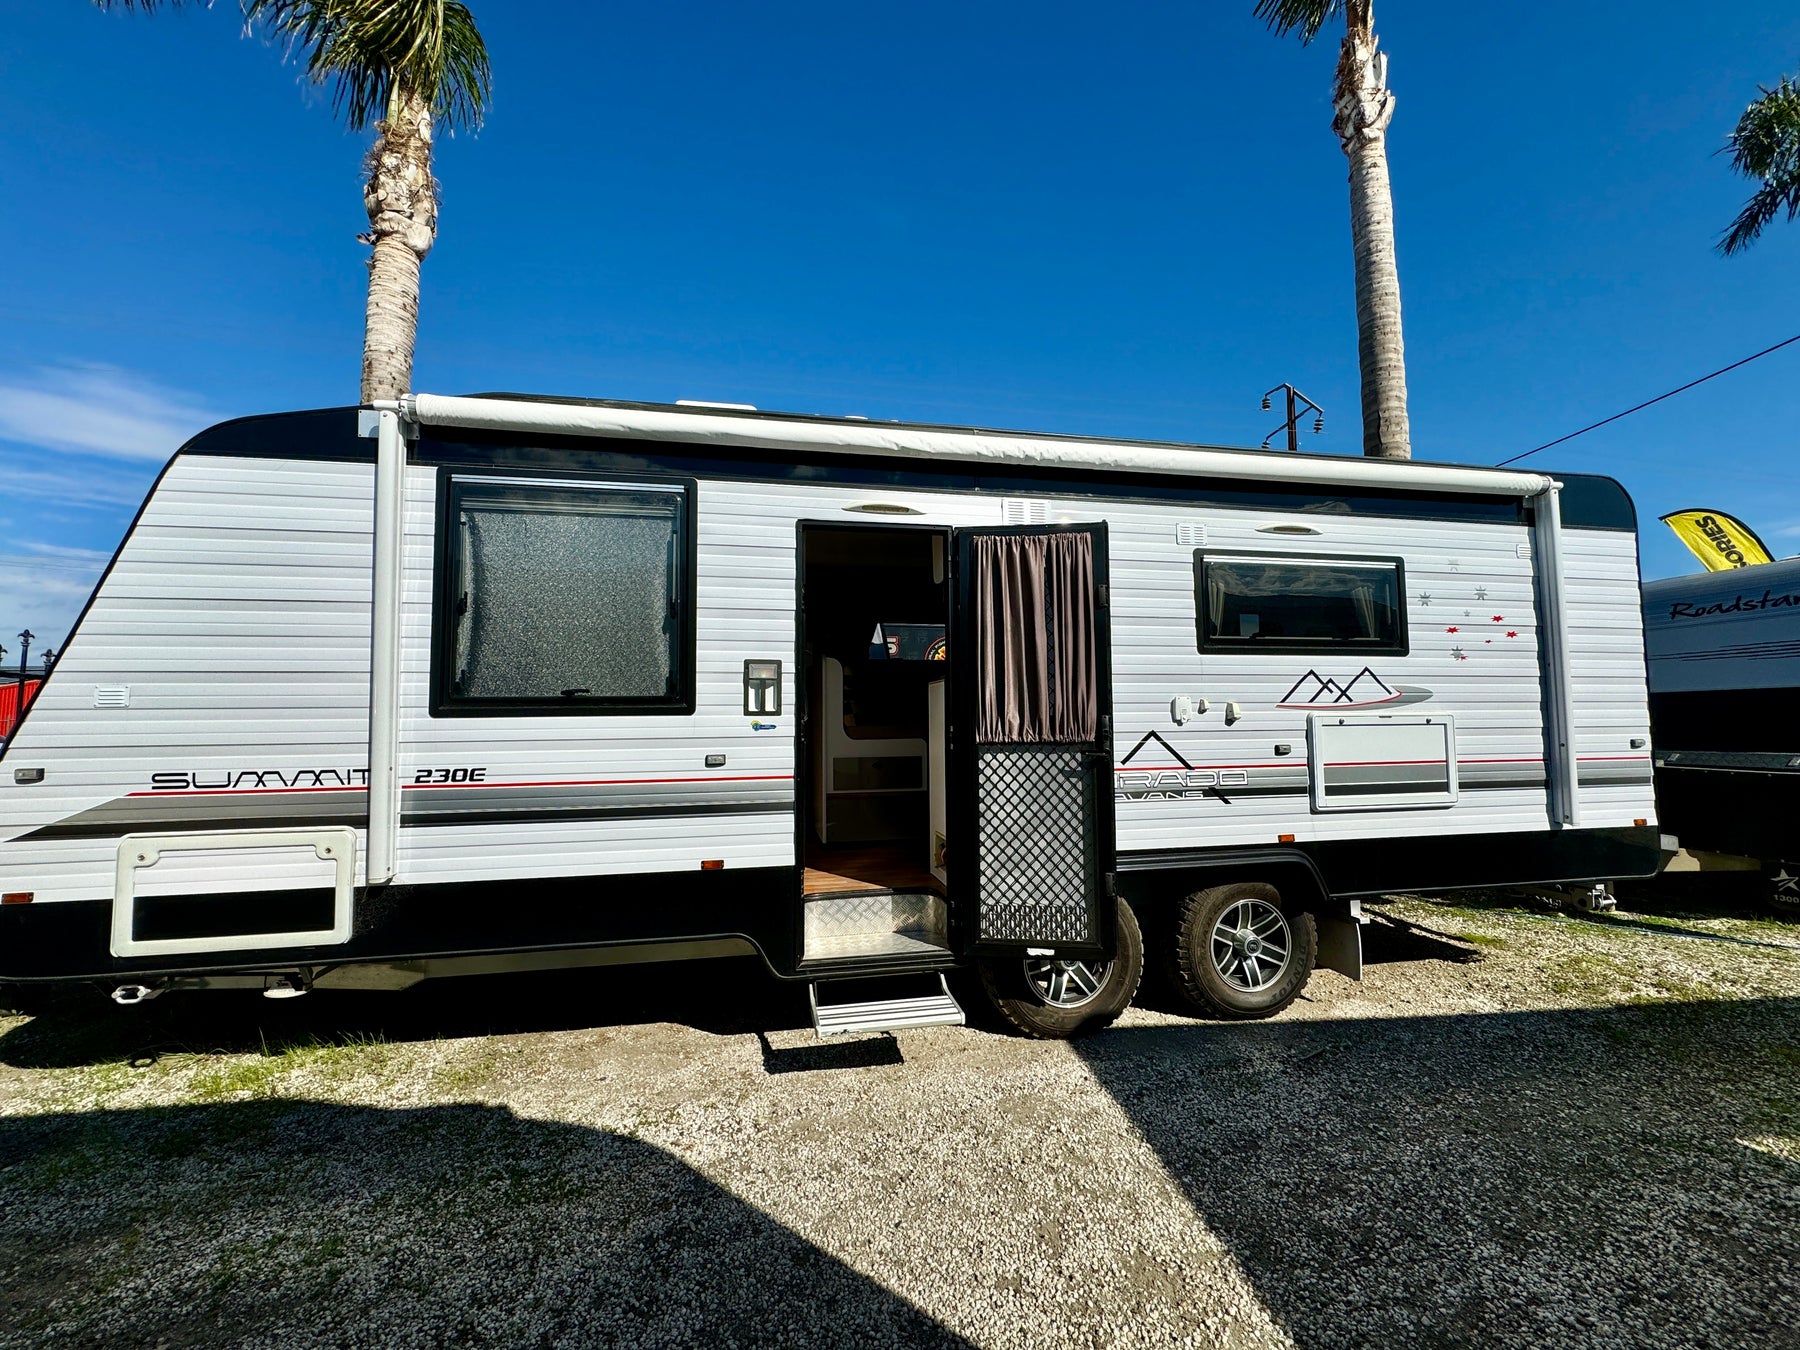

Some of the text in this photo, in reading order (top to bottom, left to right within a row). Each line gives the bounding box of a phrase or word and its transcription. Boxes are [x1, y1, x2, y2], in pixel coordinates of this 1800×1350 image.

[1694, 515, 1747, 568] ORIES
[151, 767, 488, 789] SUMMIT 230E
[1114, 769, 1248, 789] RADO
[1773, 894, 1800, 904] 1300
